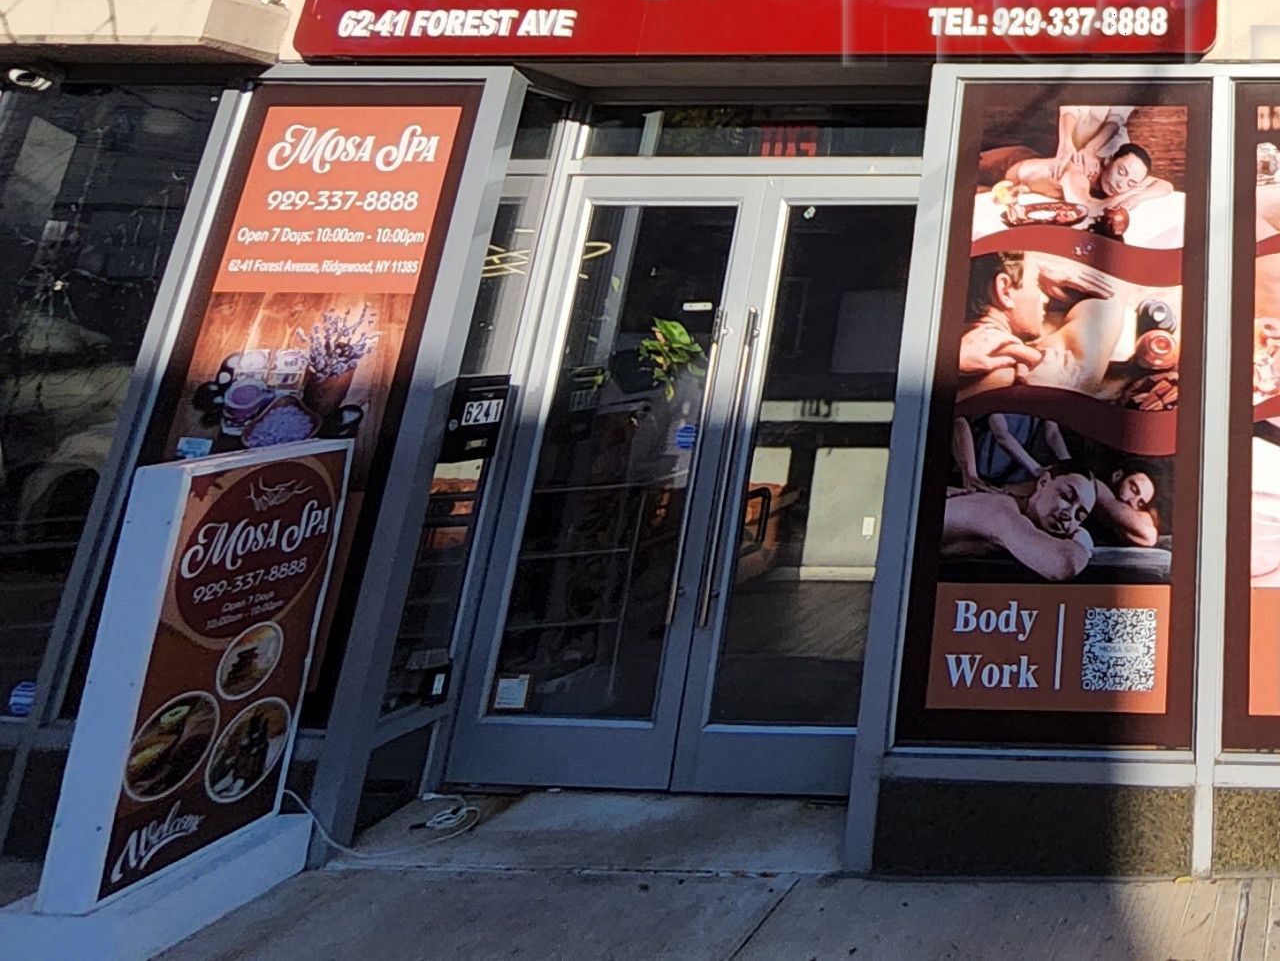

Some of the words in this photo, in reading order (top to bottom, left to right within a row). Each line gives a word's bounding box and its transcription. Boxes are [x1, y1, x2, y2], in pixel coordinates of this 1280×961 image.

[338, 9, 410, 38] 62-41
[410, 9, 518, 37] FOREST
[517, 9, 578, 37] AVE
[928, 7, 988, 36] TEL:
[992, 6, 1169, 36] 929-337-8888
[267, 190, 419, 212] 929-337-8888
[237, 227, 269, 245] Open
[272, 228, 281, 242] 7
[315, 227, 364, 243] 10:00am
[375, 228, 425, 246] 10:00pm
[254, 259, 283, 272] Forest
[375, 260, 392, 273] NY
[464, 402, 501, 423] 6241
[193, 557, 308, 605] 929-337-8888
[953, 600, 1039, 641] Body
[945, 653, 1039, 688] Work
